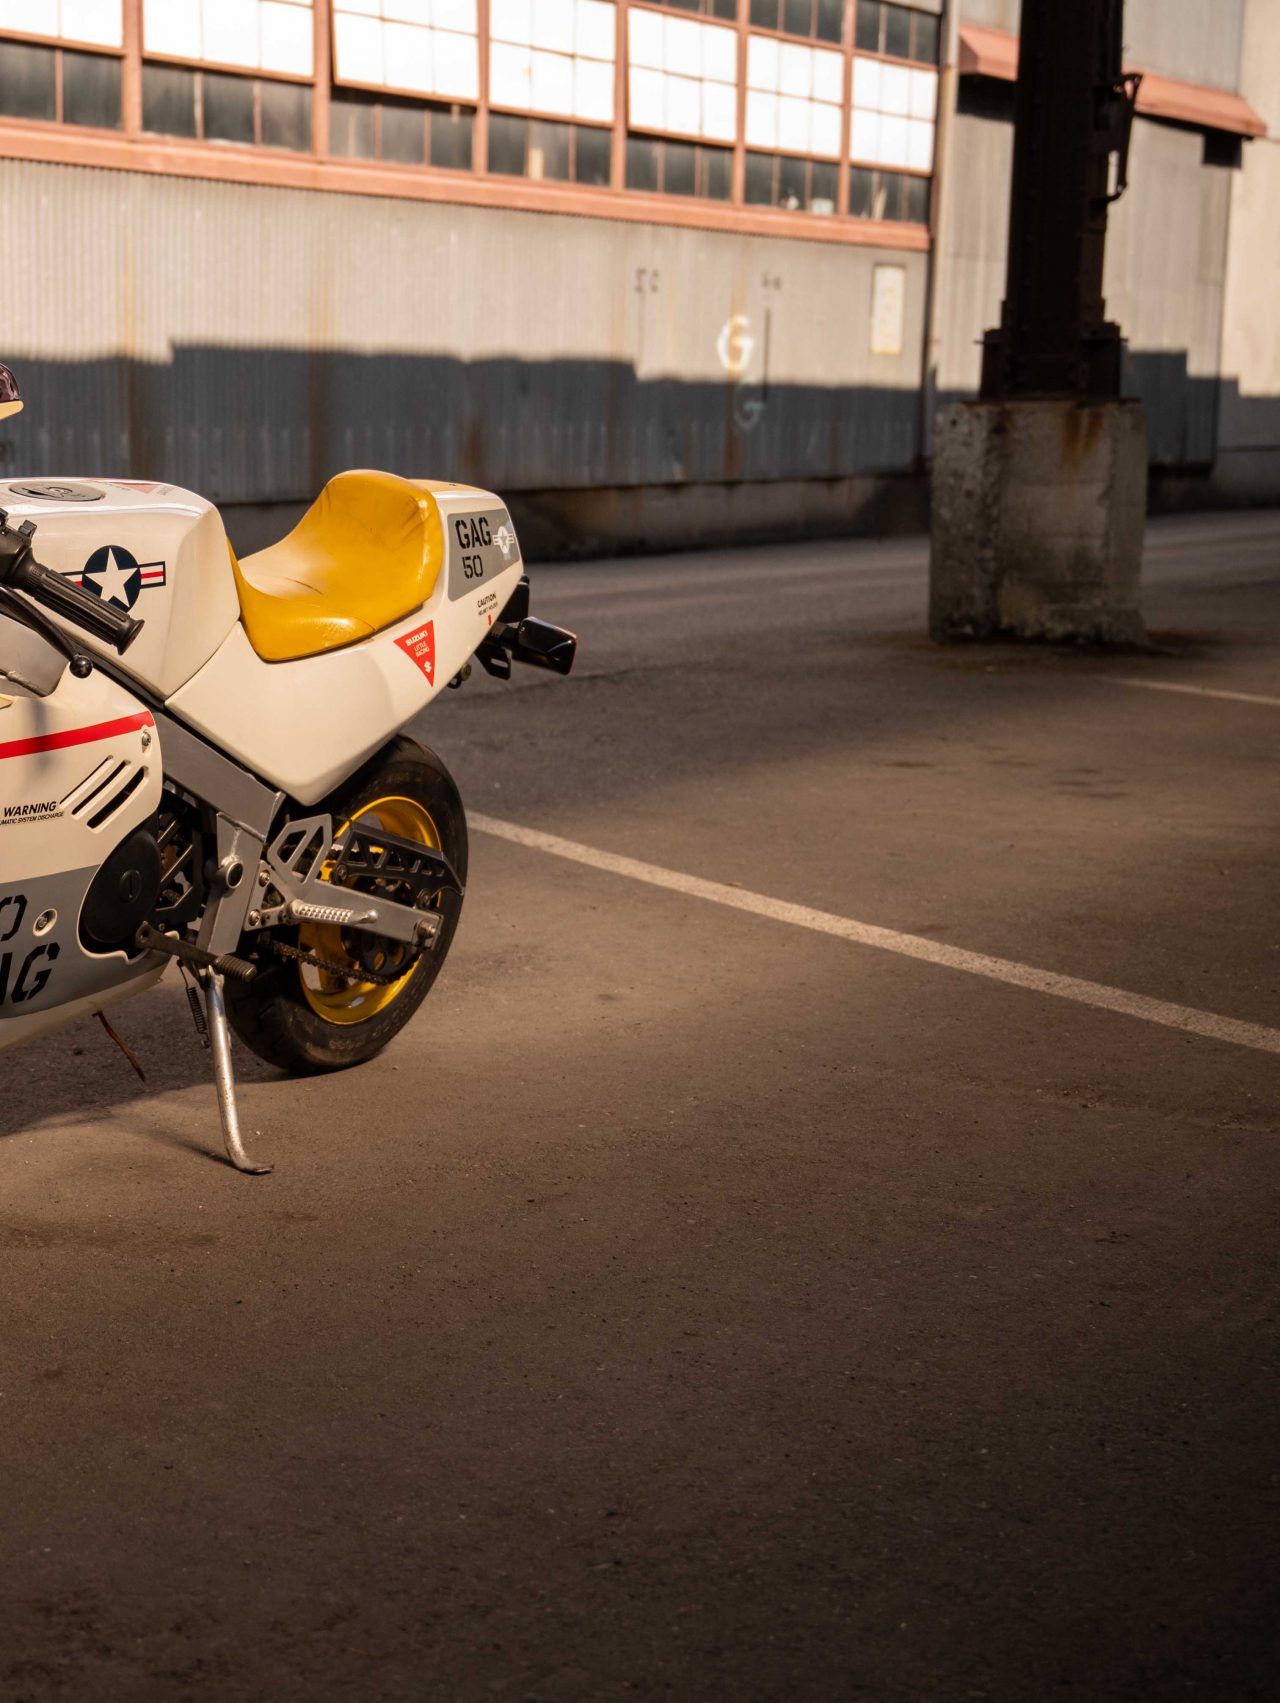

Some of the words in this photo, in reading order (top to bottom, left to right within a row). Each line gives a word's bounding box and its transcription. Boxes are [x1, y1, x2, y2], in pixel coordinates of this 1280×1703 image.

[455, 517, 491, 549] GAG
[462, 555, 483, 579] 50
[477, 592, 497, 608] CAUTION
[405, 630, 428, 646] SUZUKI
[4, 800, 57, 818] WARNING
[17, 815, 37, 824] SYSTEM
